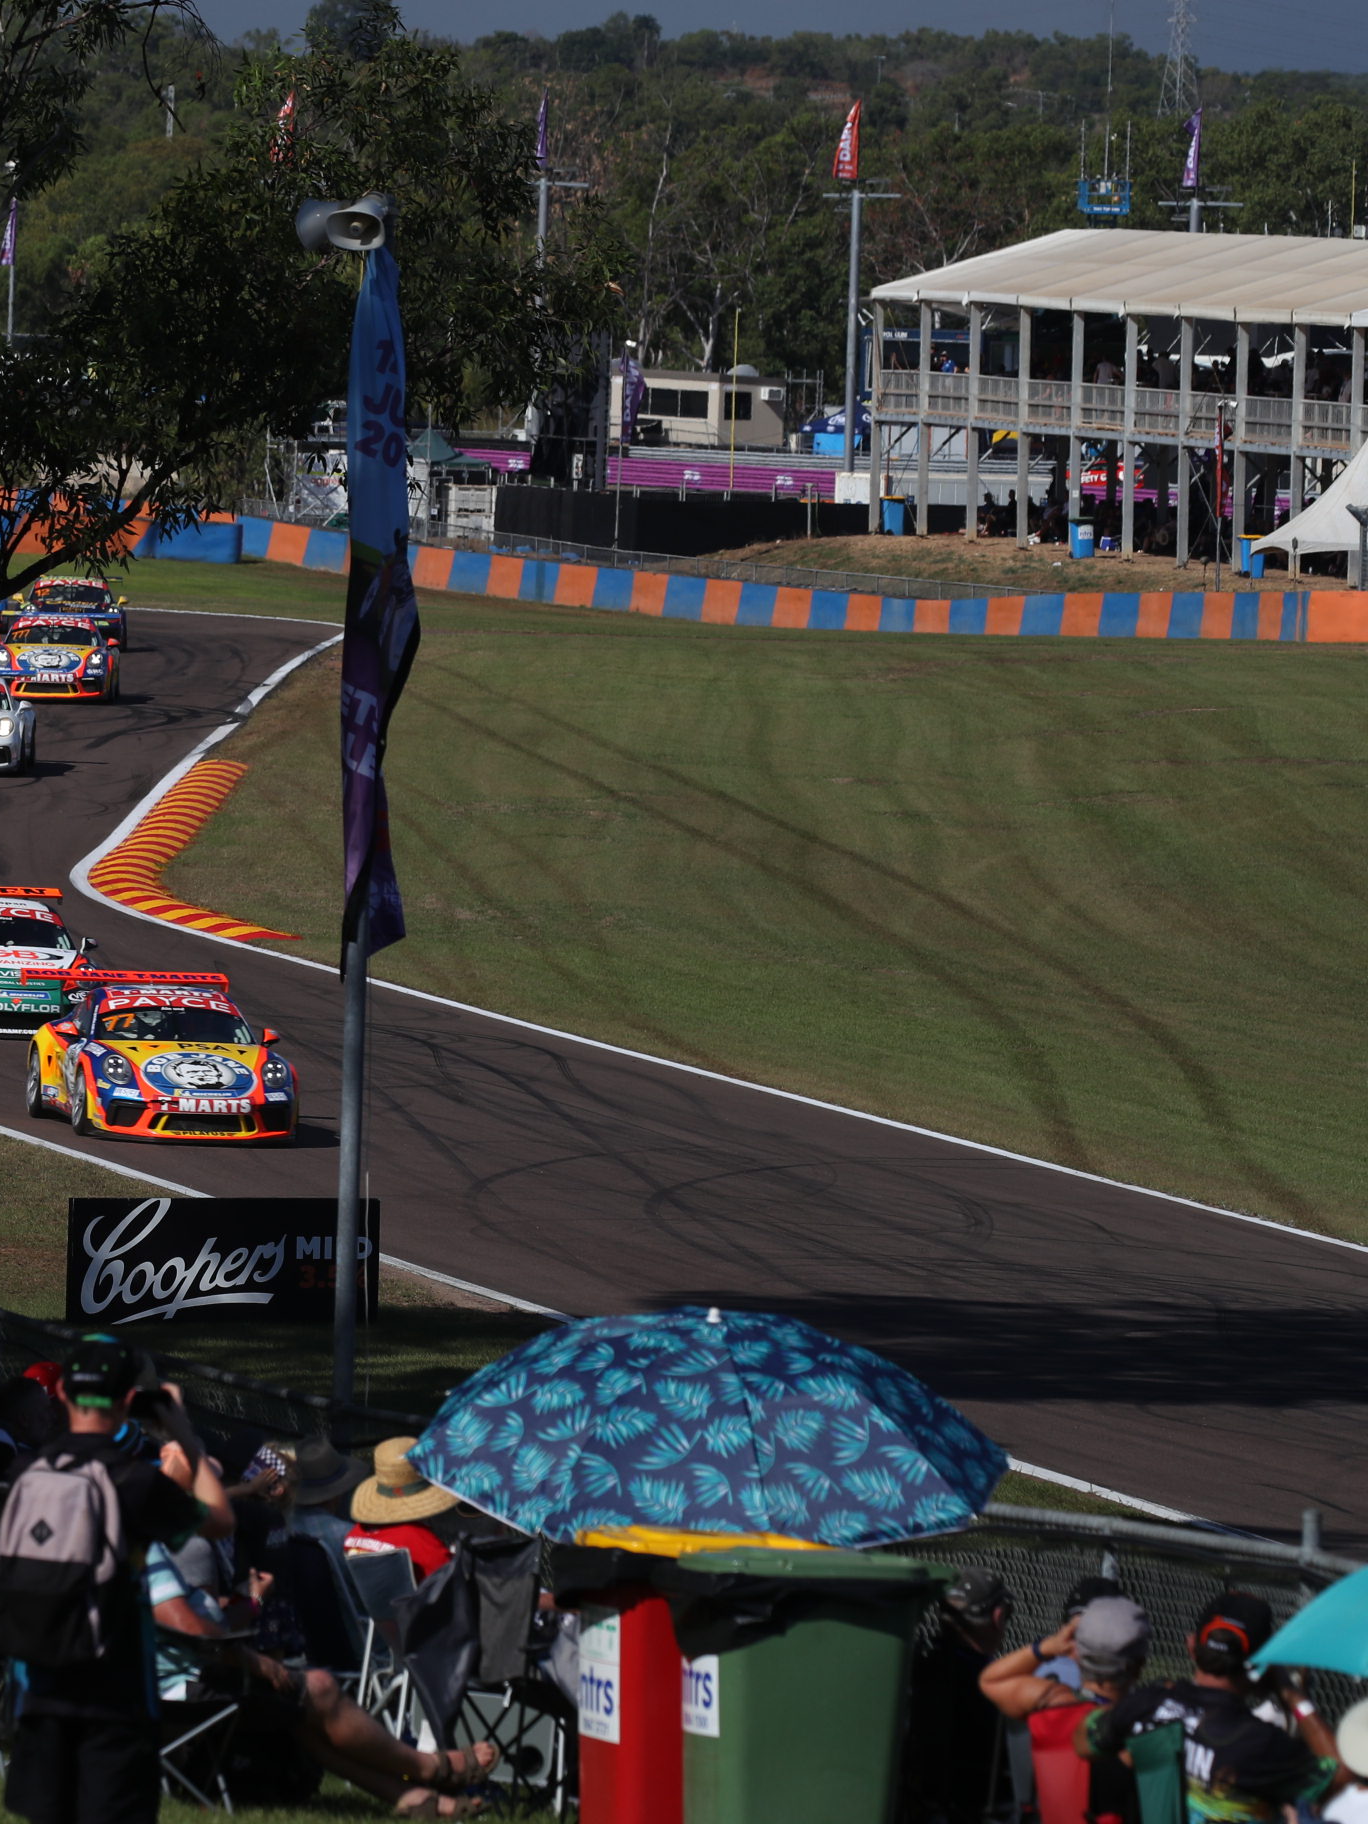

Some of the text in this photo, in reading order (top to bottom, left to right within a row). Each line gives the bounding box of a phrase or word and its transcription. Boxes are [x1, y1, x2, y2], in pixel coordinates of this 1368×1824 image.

[18, 619, 90, 630] PAYCE
[25, 969, 72, 977] BOB
[77, 971, 130, 979] JANE
[108, 996, 232, 1013] PAYCE
[176, 1042, 230, 1052] PSA
[146, 1052, 250, 1075] BOB JANE
[158, 1096, 252, 1114] T-MARTS
[295, 1235, 373, 1260] MID
[81, 1198, 287, 1320] Coopers
